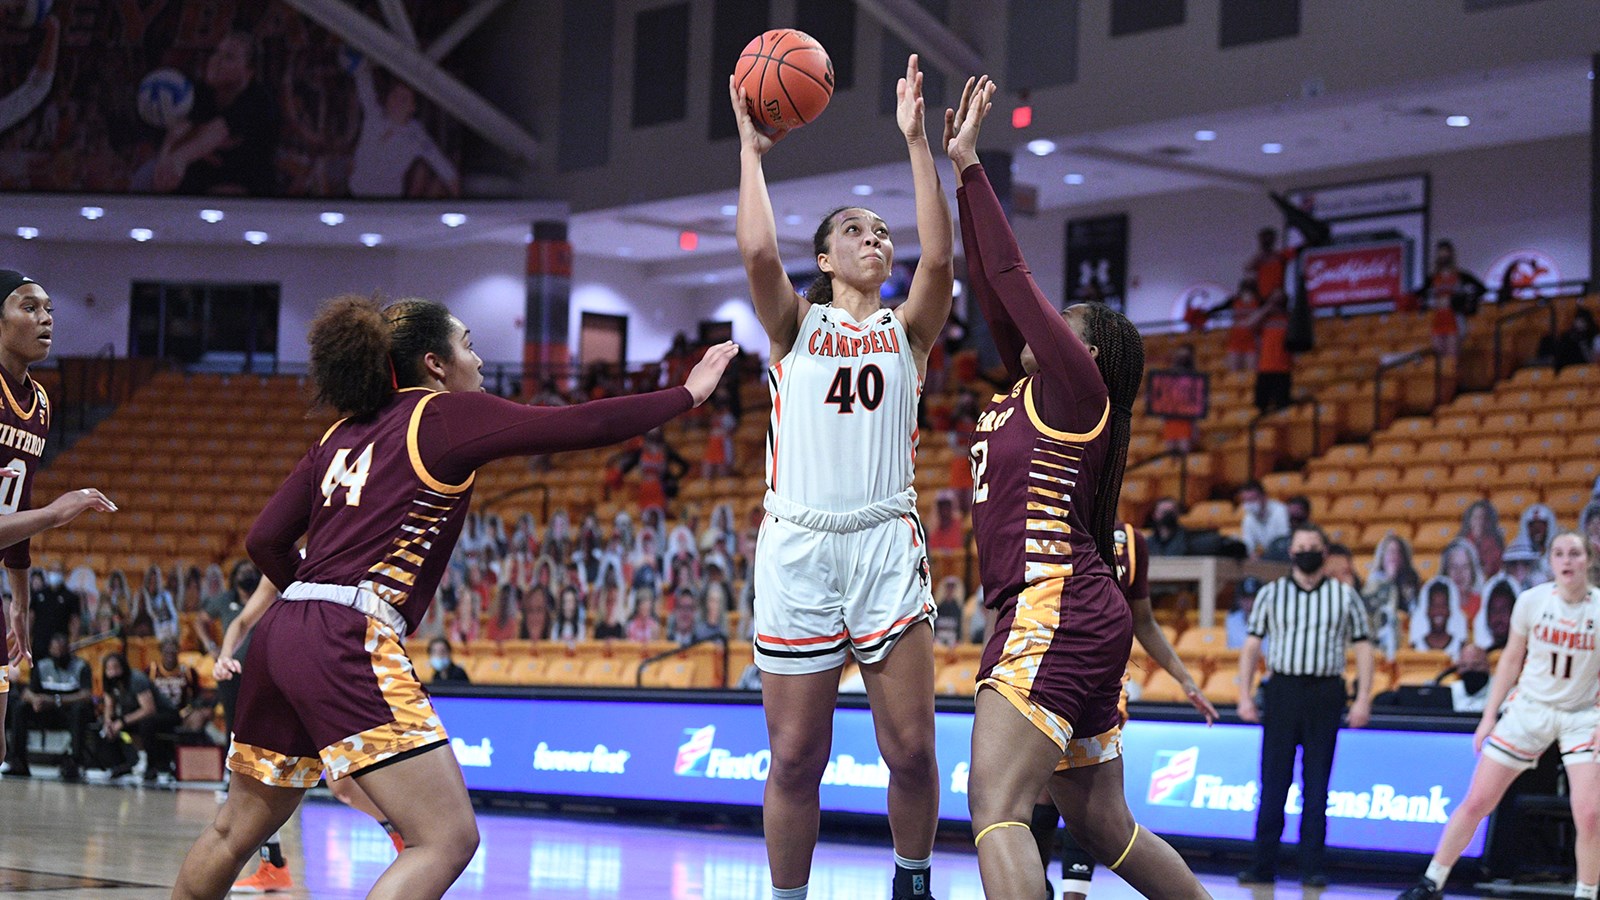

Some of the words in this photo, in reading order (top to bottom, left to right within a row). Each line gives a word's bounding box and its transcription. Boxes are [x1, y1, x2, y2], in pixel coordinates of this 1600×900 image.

[824, 363, 885, 414] 40
[320, 442, 375, 507] 44
[1550, 652, 1573, 679] 11
